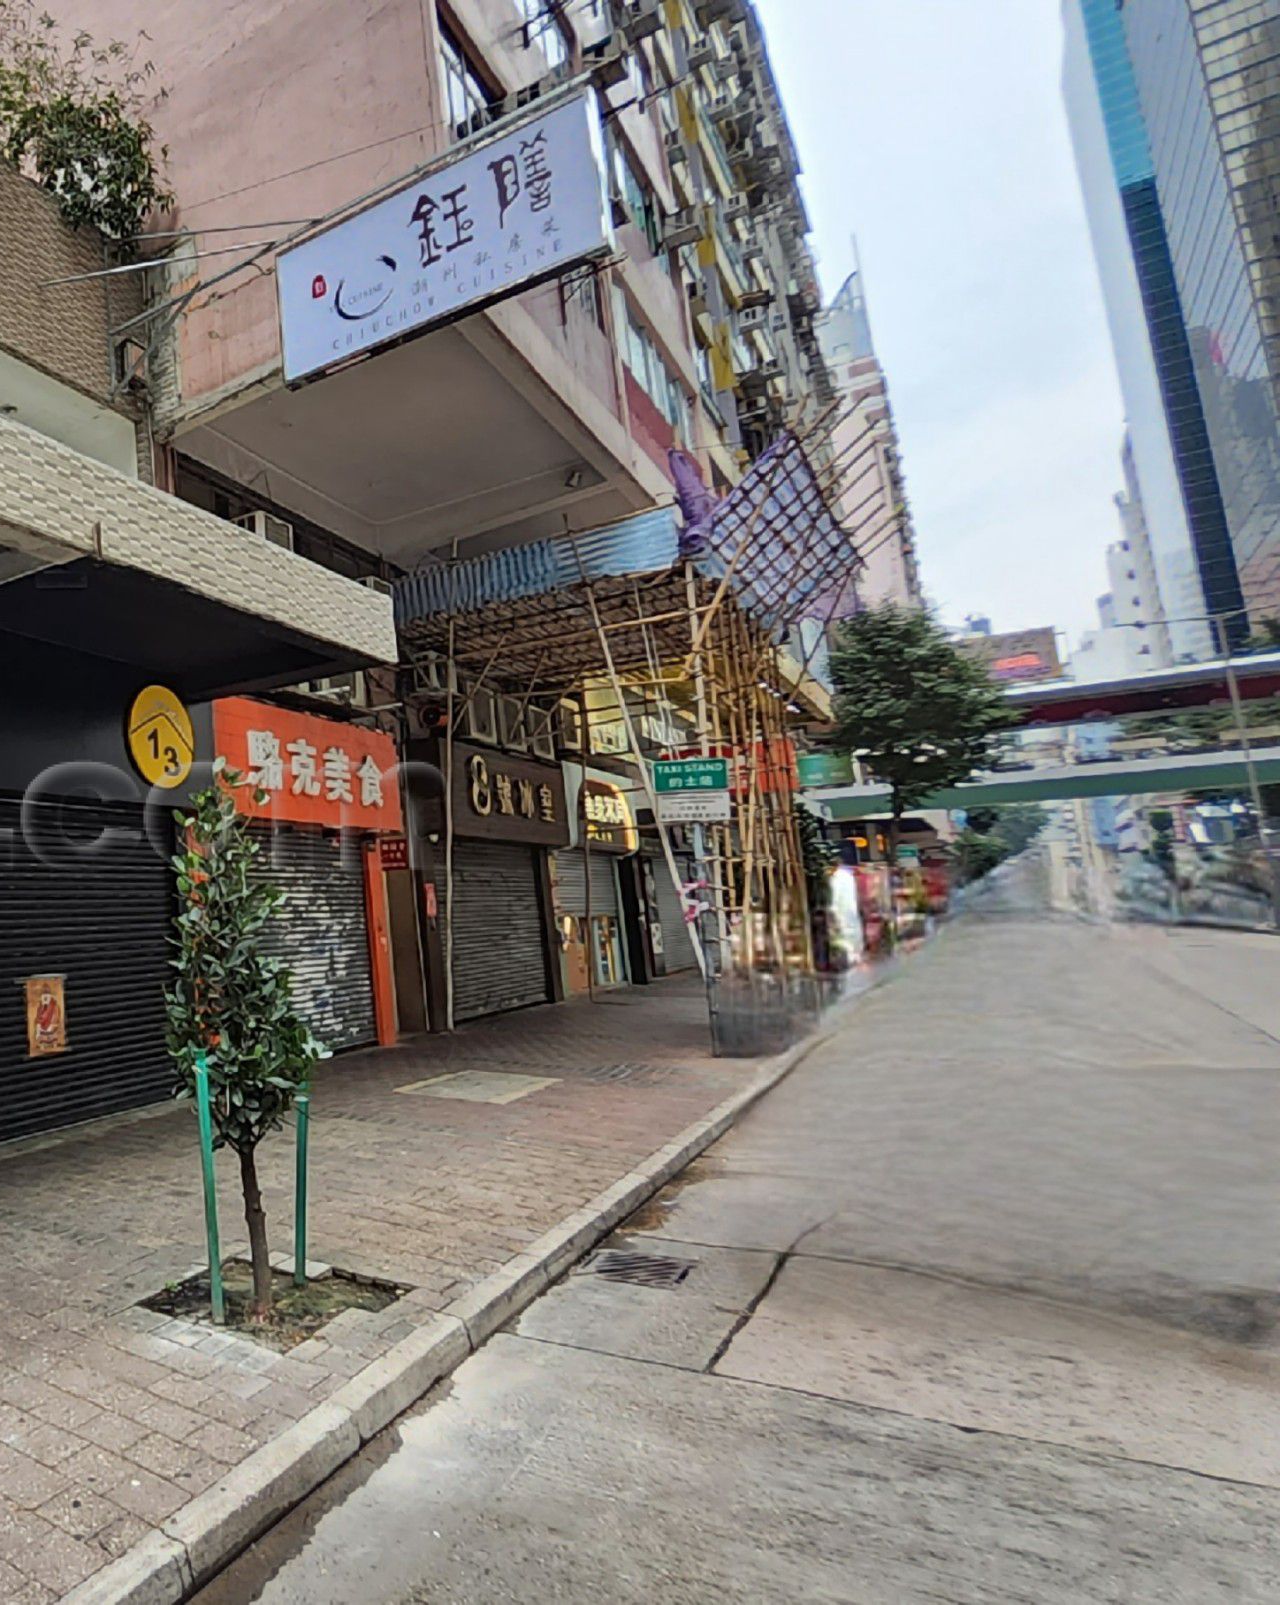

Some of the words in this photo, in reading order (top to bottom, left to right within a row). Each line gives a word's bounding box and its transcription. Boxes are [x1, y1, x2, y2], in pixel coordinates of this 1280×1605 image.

[457, 238, 563, 294] CUISINE
[656, 765, 682, 774] TAXI
[684, 762, 724, 772] STAND
